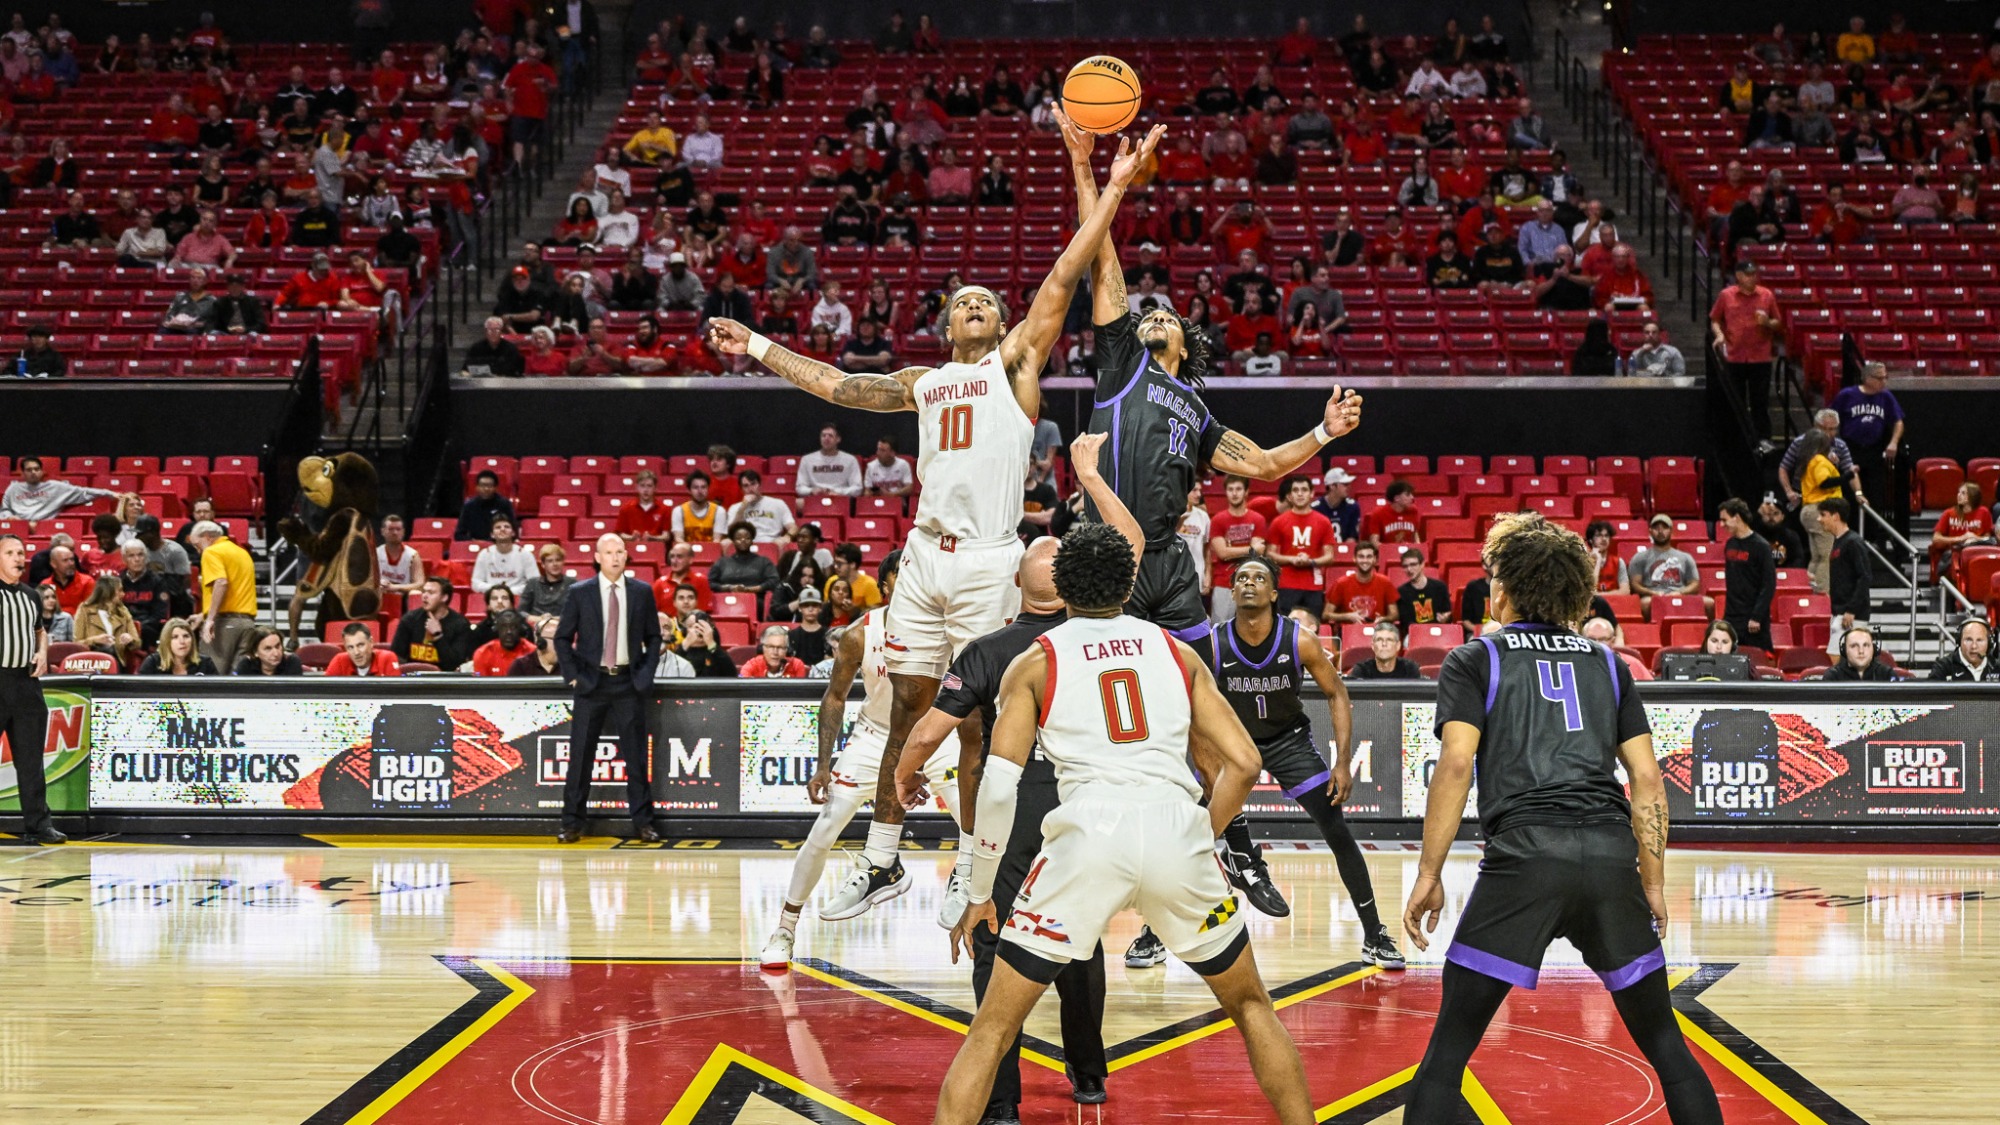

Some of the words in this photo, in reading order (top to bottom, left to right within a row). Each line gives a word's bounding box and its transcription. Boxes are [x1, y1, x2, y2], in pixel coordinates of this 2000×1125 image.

[924, 380, 988, 408] MARYLAND
[1850, 404, 1885, 419] NIAGARA
[939, 404, 973, 451] 10
[1292, 525, 1312, 546] M
[1385, 521, 1415, 533] MARYLAND
[942, 537, 953, 549] M
[1413, 597, 1434, 622] M
[1083, 639, 1144, 661] CAREY
[1505, 633, 1592, 653] BAYLESS
[65, 659, 111, 670] MARYLAND
[1227, 675, 1290, 693] NIAGARA
[1098, 668, 1151, 744] 0
[1536, 659, 1584, 732] 4
[1256, 695, 1267, 719] 1
[167, 718, 245, 748] MAKE
[556, 742, 618, 761] BD
[669, 738, 712, 779] M
[1884, 747, 1947, 767] BUD
[111, 753, 214, 783] CLUTCH
[221, 753, 300, 784] PICKS
[379, 756, 445, 778] BUD
[544, 760, 627, 781] LIHT
[1702, 762, 1769, 785] BUD
[1872, 767, 1960, 787] LIGHT
[373, 779, 451, 802] LIGHT
[1695, 786, 1776, 809] LIGHT
[773, 840, 960, 851] YEA
